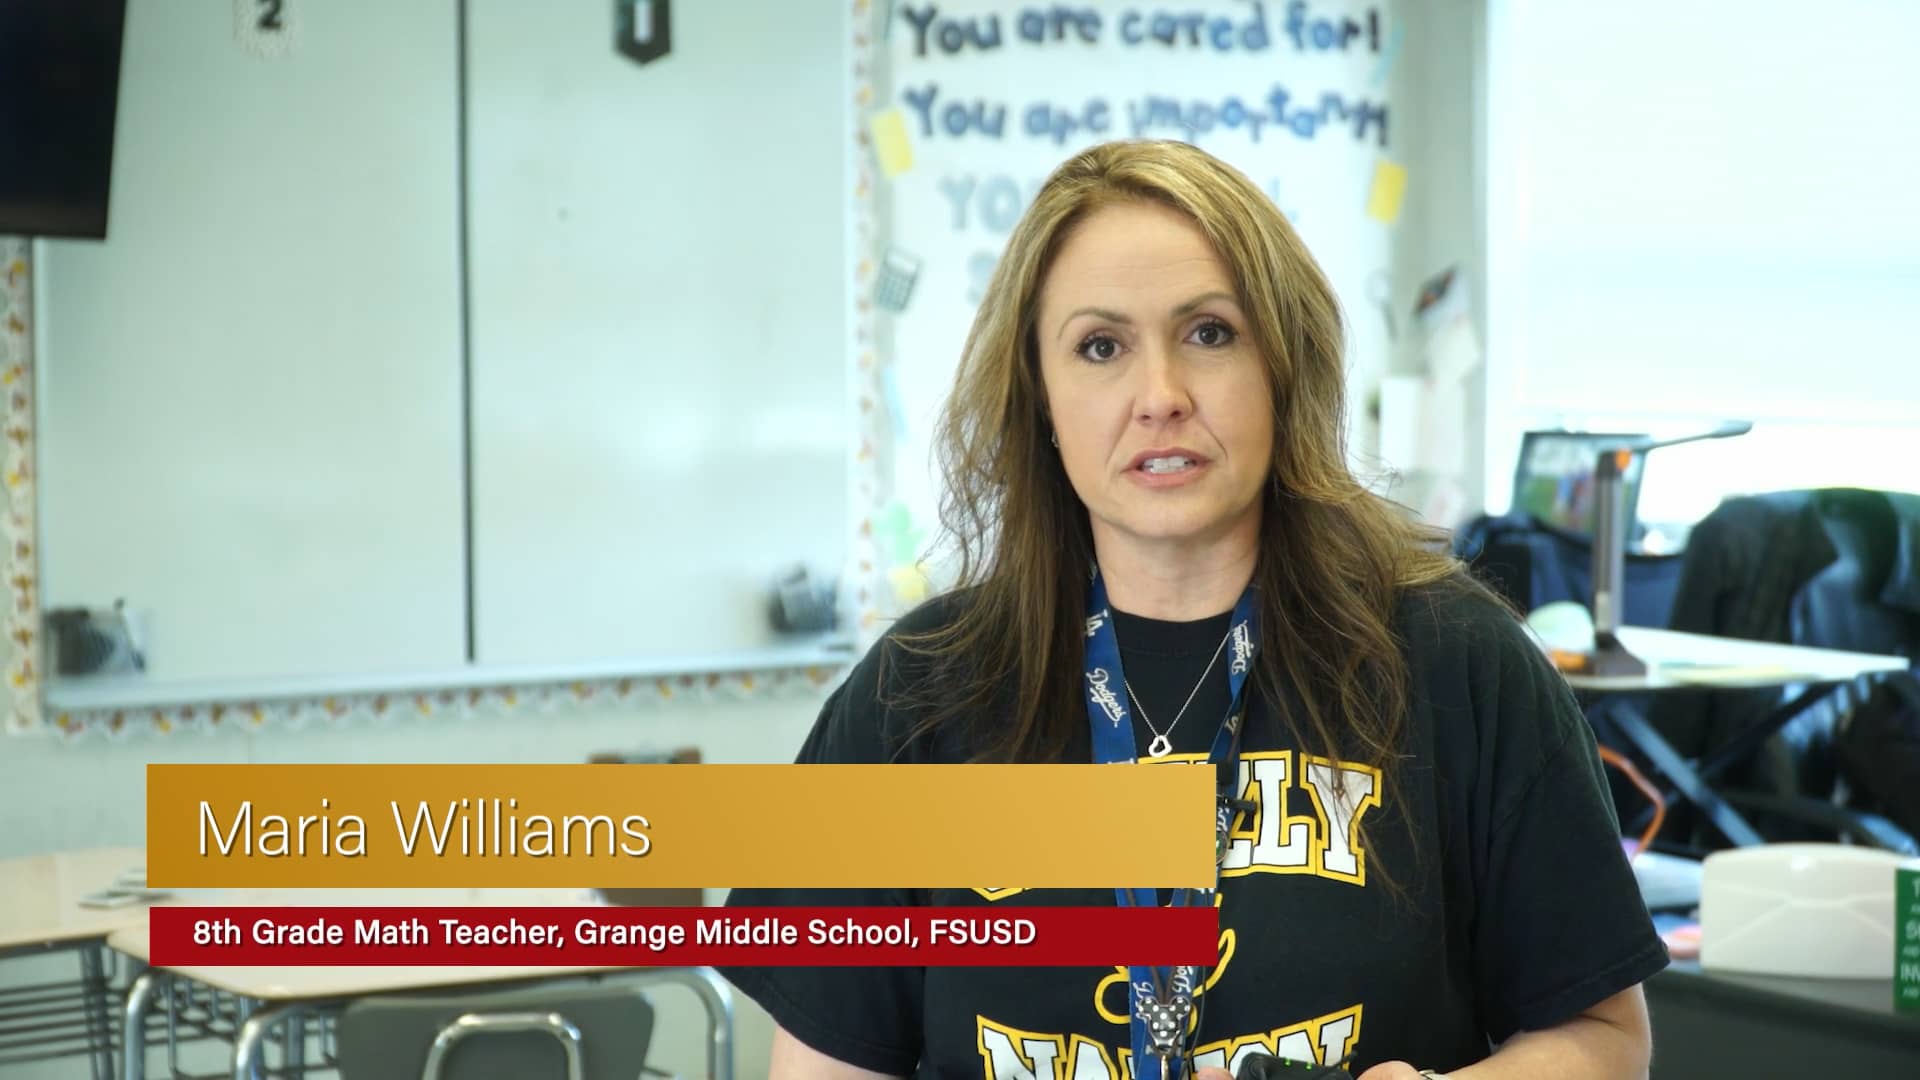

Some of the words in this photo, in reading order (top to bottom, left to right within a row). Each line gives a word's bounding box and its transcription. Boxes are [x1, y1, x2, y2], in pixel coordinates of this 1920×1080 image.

[903, 5, 1001, 57] You
[1018, 7, 1101, 44] are
[1119, 0, 1269, 50] cared
[1287, 0, 1380, 52] for!
[903, 83, 1006, 139] You
[1024, 98, 1111, 146] are
[938, 173, 1036, 234] YO
[1231, 619, 1255, 675] Dodgers
[1085, 667, 1127, 728] Dodgers
